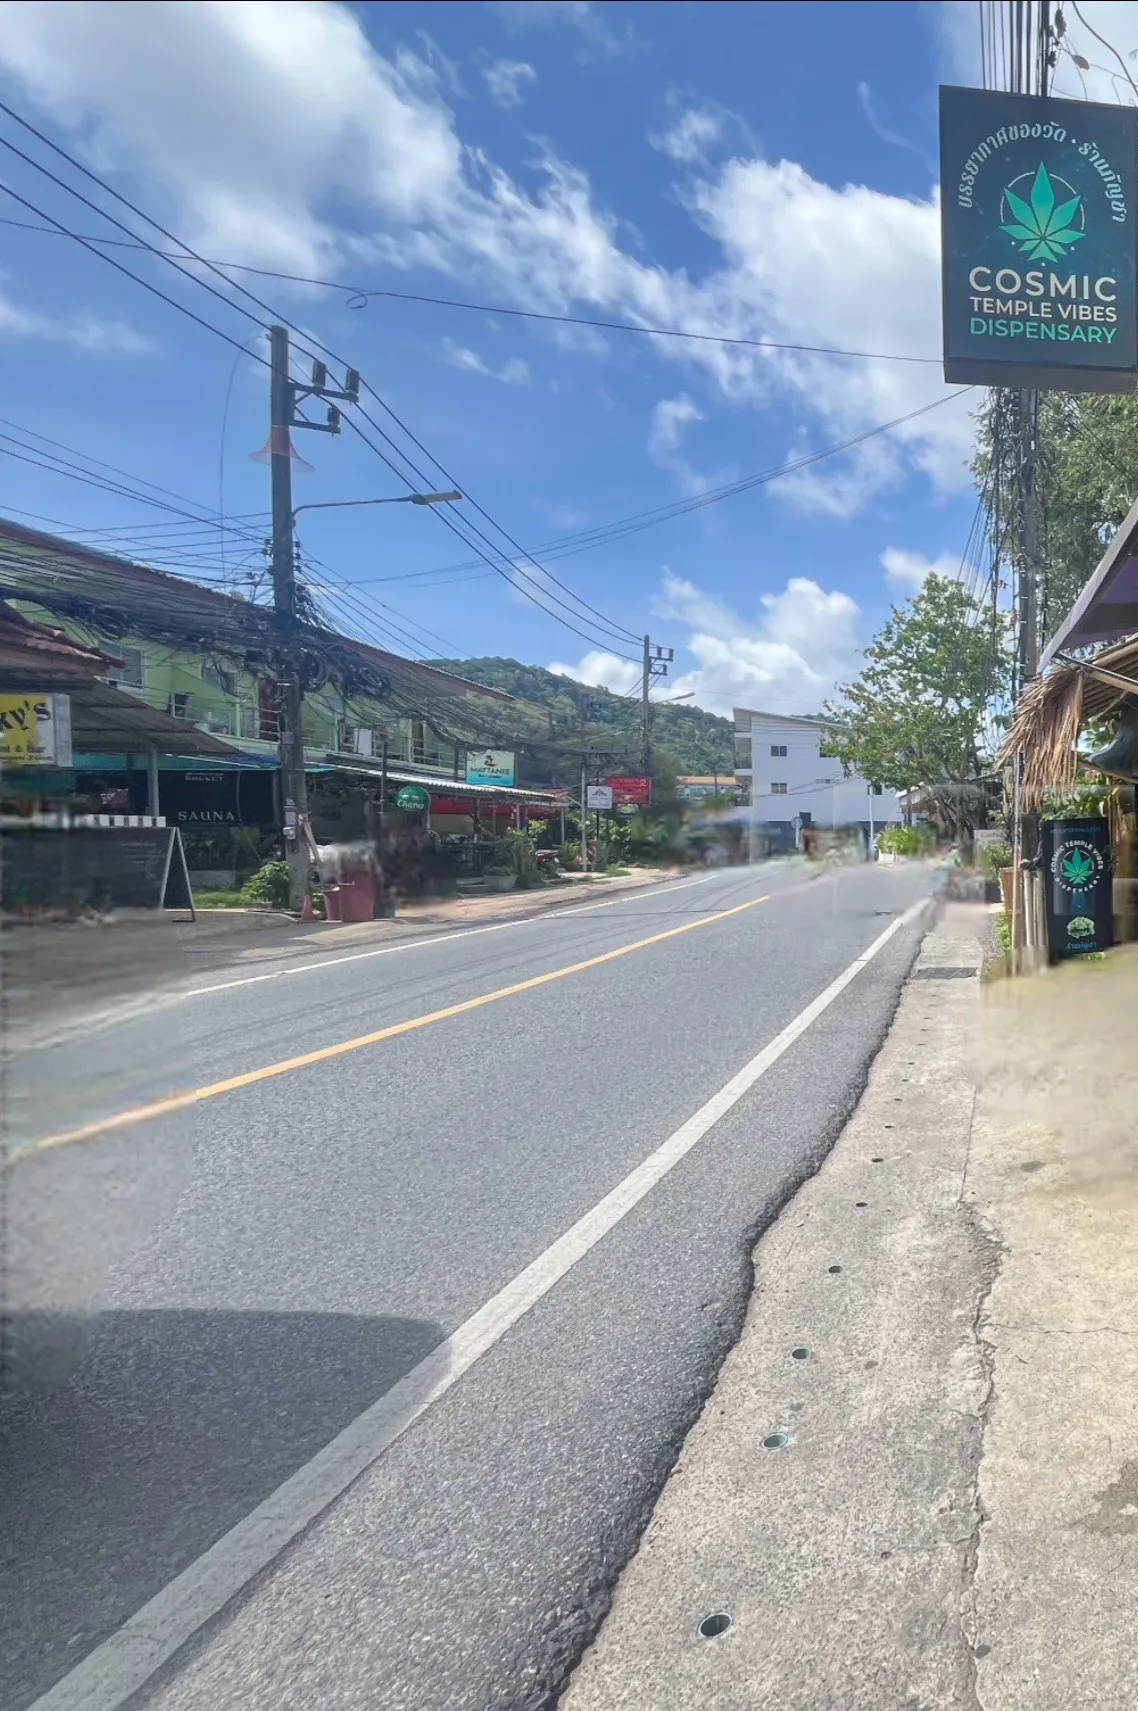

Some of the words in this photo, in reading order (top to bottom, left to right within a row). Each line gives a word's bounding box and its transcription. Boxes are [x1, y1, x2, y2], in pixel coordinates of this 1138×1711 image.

[1078, 141, 1128, 223] ร้านกัญชา
[969, 266, 1117, 301] COSMIC
[969, 296, 1053, 318] TEMPLE
[1057, 303, 1118, 323] VIBES
[970, 317, 1117, 344] DISPENSARY
[178, 810, 235, 821] SAUNA
[1050, 845, 1065, 873] COSMIC
[1064, 839, 1094, 850] TEMPLE
[1092, 848, 1104, 870] VIBES
